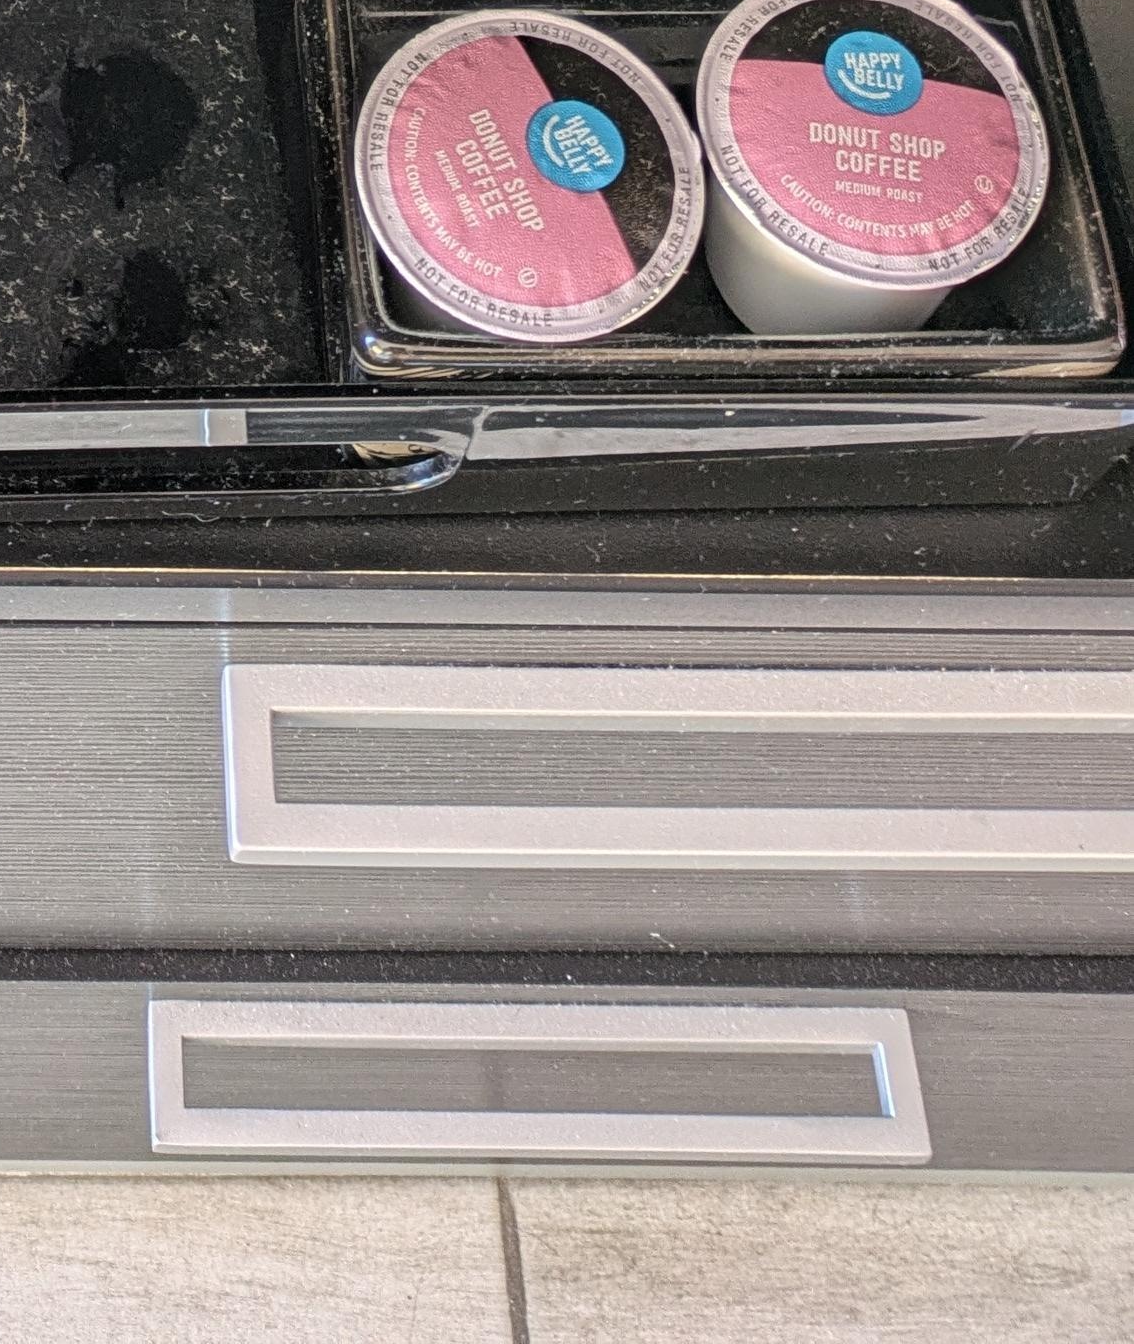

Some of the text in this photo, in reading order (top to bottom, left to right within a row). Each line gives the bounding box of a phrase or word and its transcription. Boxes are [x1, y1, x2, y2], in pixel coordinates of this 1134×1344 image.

[509, 21, 642, 85] NOT FOR RESALE
[719, 14, 760, 61] RESALE
[843, 51, 902, 71] HAPPY
[370, 53, 427, 171] NOT FOR RESALE
[853, 68, 905, 92] BELLY
[1000, 75, 1022, 102] NOT
[469, 109, 545, 232] DONUT SHOP
[553, 129, 593, 174] BELLY
[565, 114, 615, 167] HAPPY
[809, 122, 947, 161] DONUT SHOP
[834, 148, 923, 183] COFFEE
[434, 149, 480, 228] MEDIUM ROAST
[455, 138, 511, 220] COFFEE
[720, 145, 829, 257] NOT FOR RESALE
[780, 174, 976, 239] CAUTION: CONTENTS MAY BE HOT
[834, 180, 923, 203] MEDIUM ROAST
[405, 164, 440, 228] CONTENTS
[434, 226, 460, 251] MAY
[456, 246, 475, 263] BE
[473, 257, 504, 278] HOT
[639, 166, 691, 291] NOT FOR RESALE
[928, 187, 1031, 271] NOT FOR RESALE
[415, 257, 553, 327] NOT FOR RESALE
